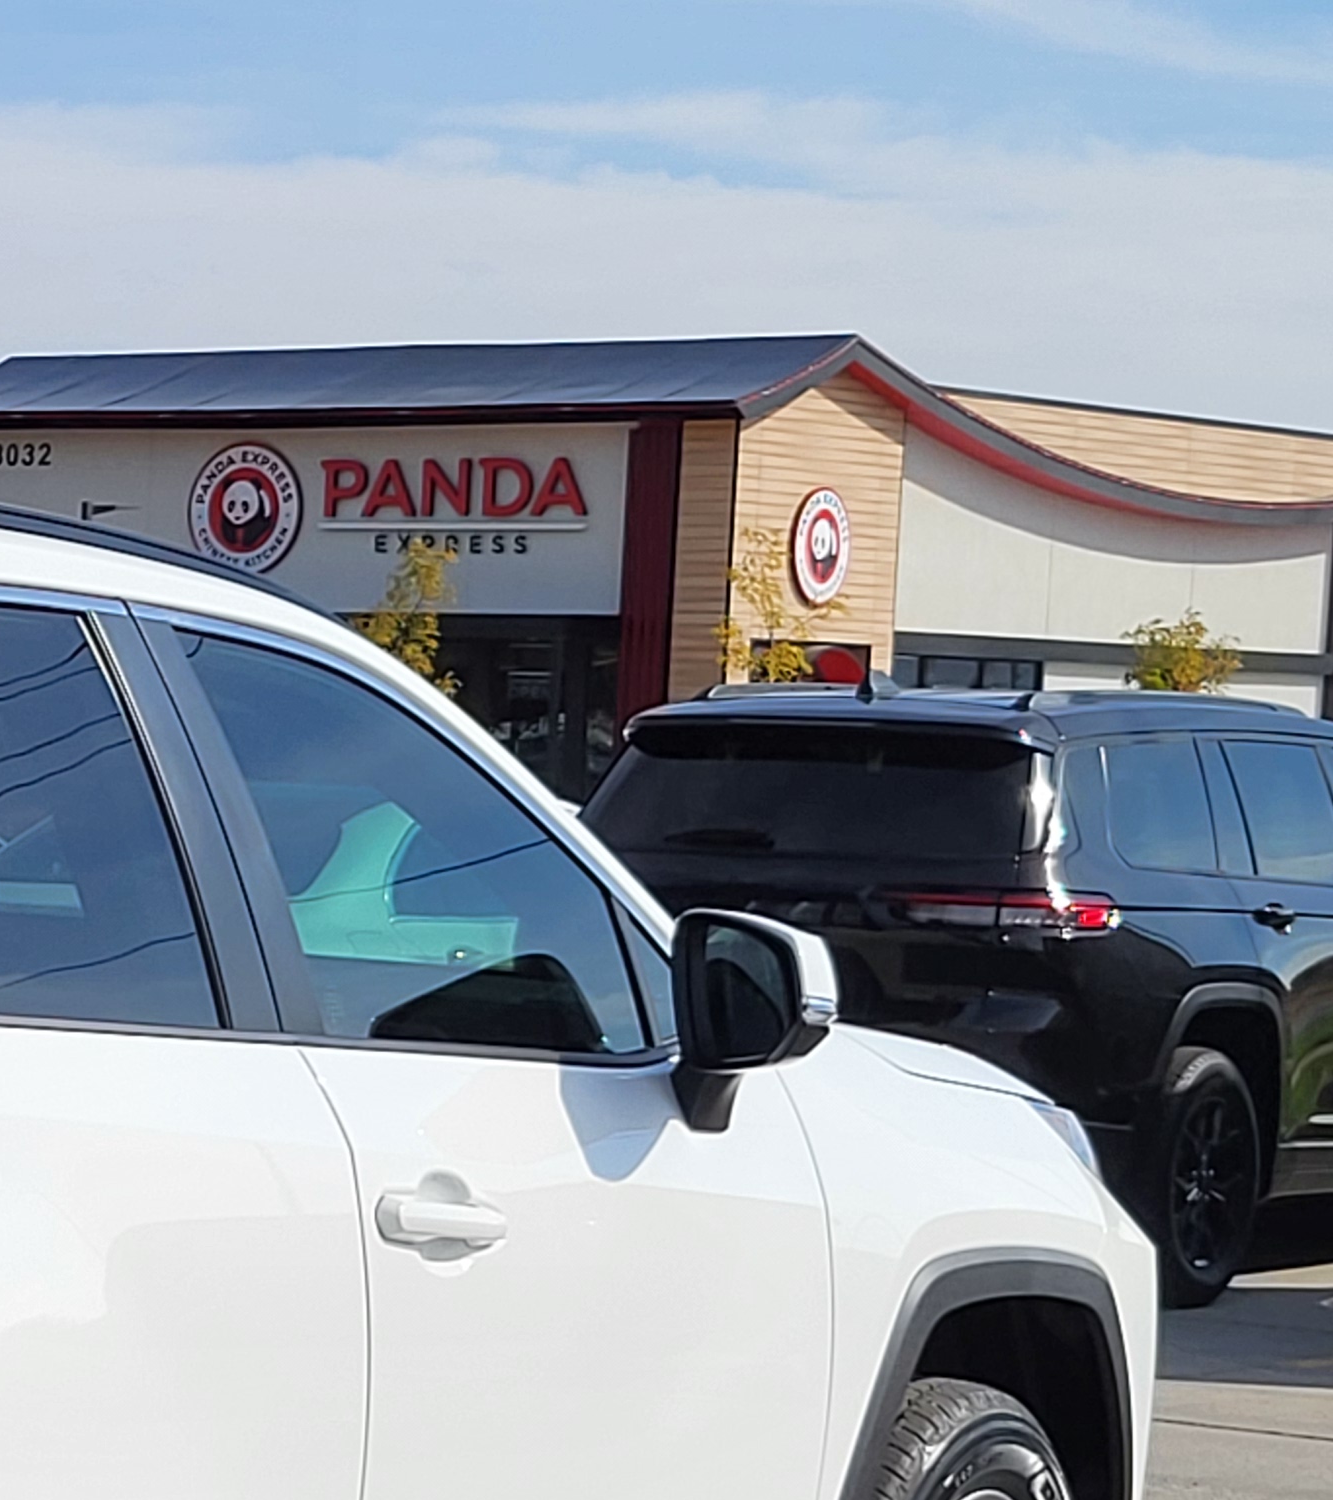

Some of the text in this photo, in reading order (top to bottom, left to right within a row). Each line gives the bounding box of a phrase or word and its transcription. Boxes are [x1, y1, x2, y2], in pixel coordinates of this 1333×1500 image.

[195, 449, 293, 505] PANDA EXPRESS
[319, 457, 589, 518] PANDA
[373, 534, 529, 554] EXPRESS
